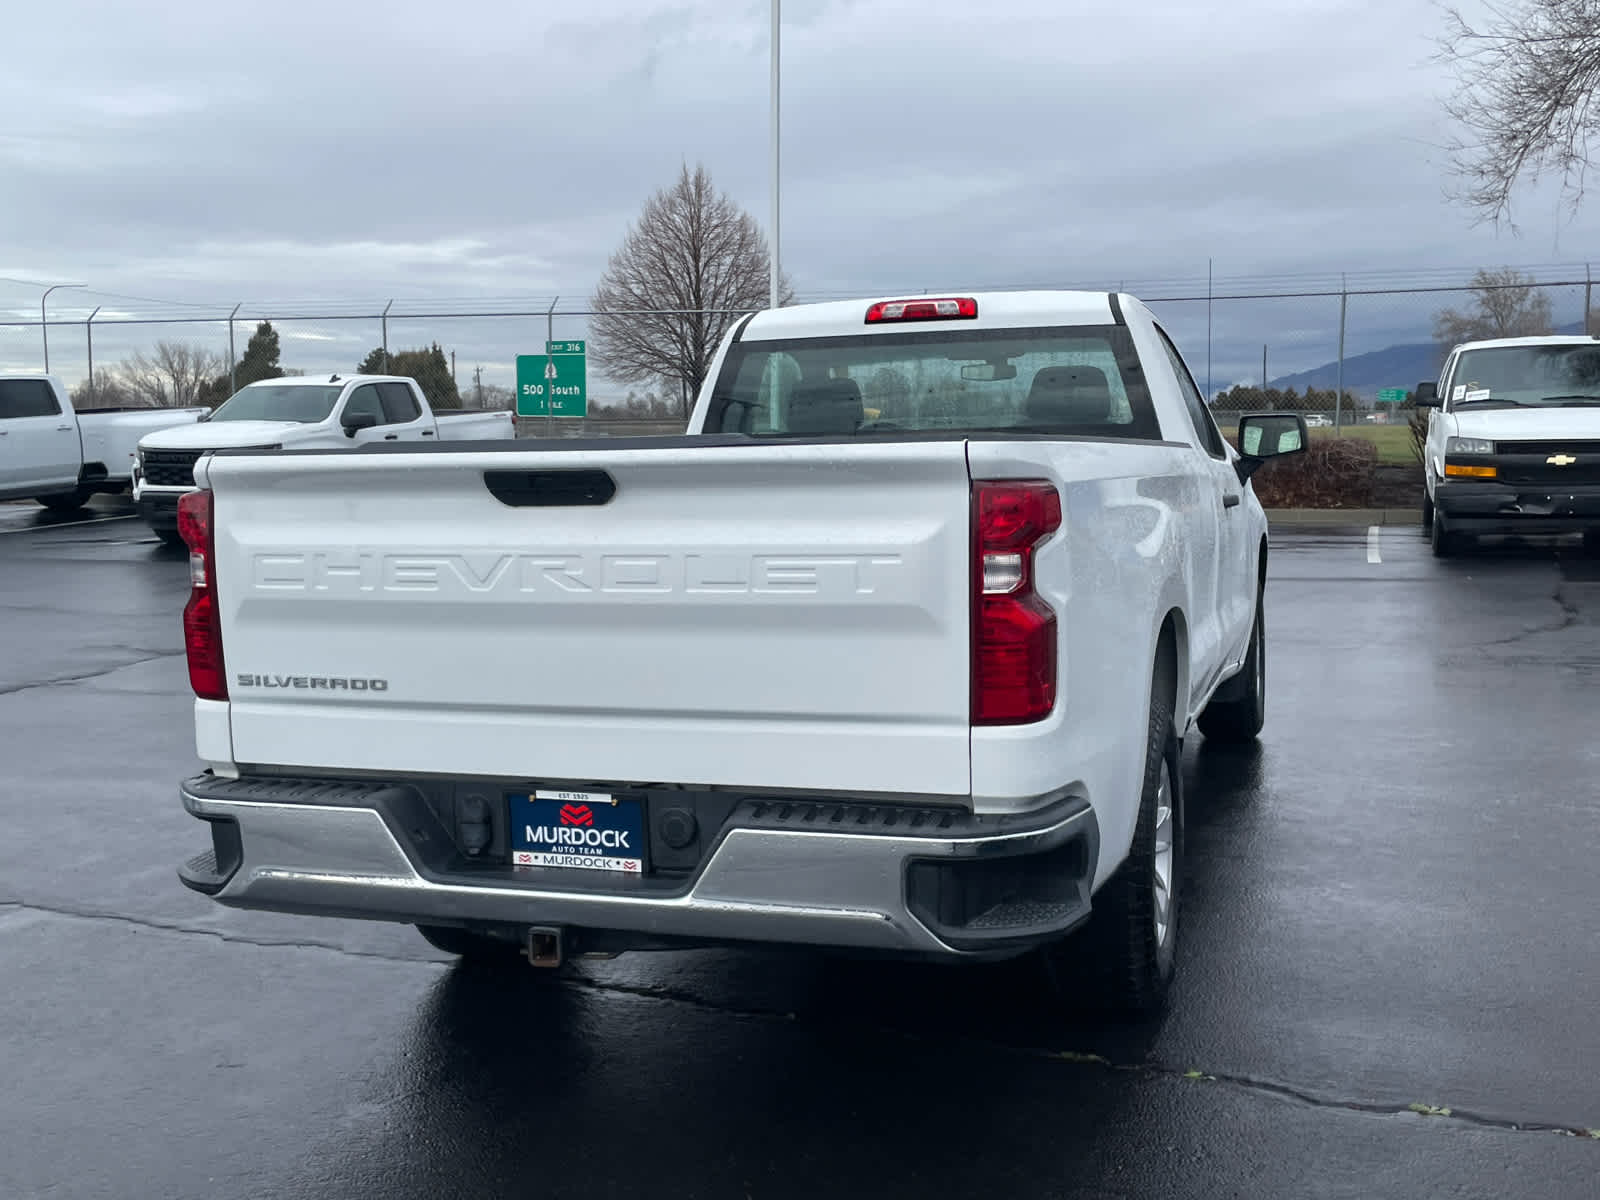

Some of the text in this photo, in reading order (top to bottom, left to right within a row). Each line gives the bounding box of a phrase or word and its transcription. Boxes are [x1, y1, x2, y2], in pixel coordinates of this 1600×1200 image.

[567, 343, 580, 351] 316
[523, 384, 580, 395] 500 South
[540, 400, 544, 408] 1
[252, 552, 903, 593] CHEVROLET
[237, 673, 388, 691] SILVERADO
[525, 825, 630, 849] MURDOCK
[551, 845, 603, 855] AUTO TEAM
[543, 855, 612, 868] MURDOCK
